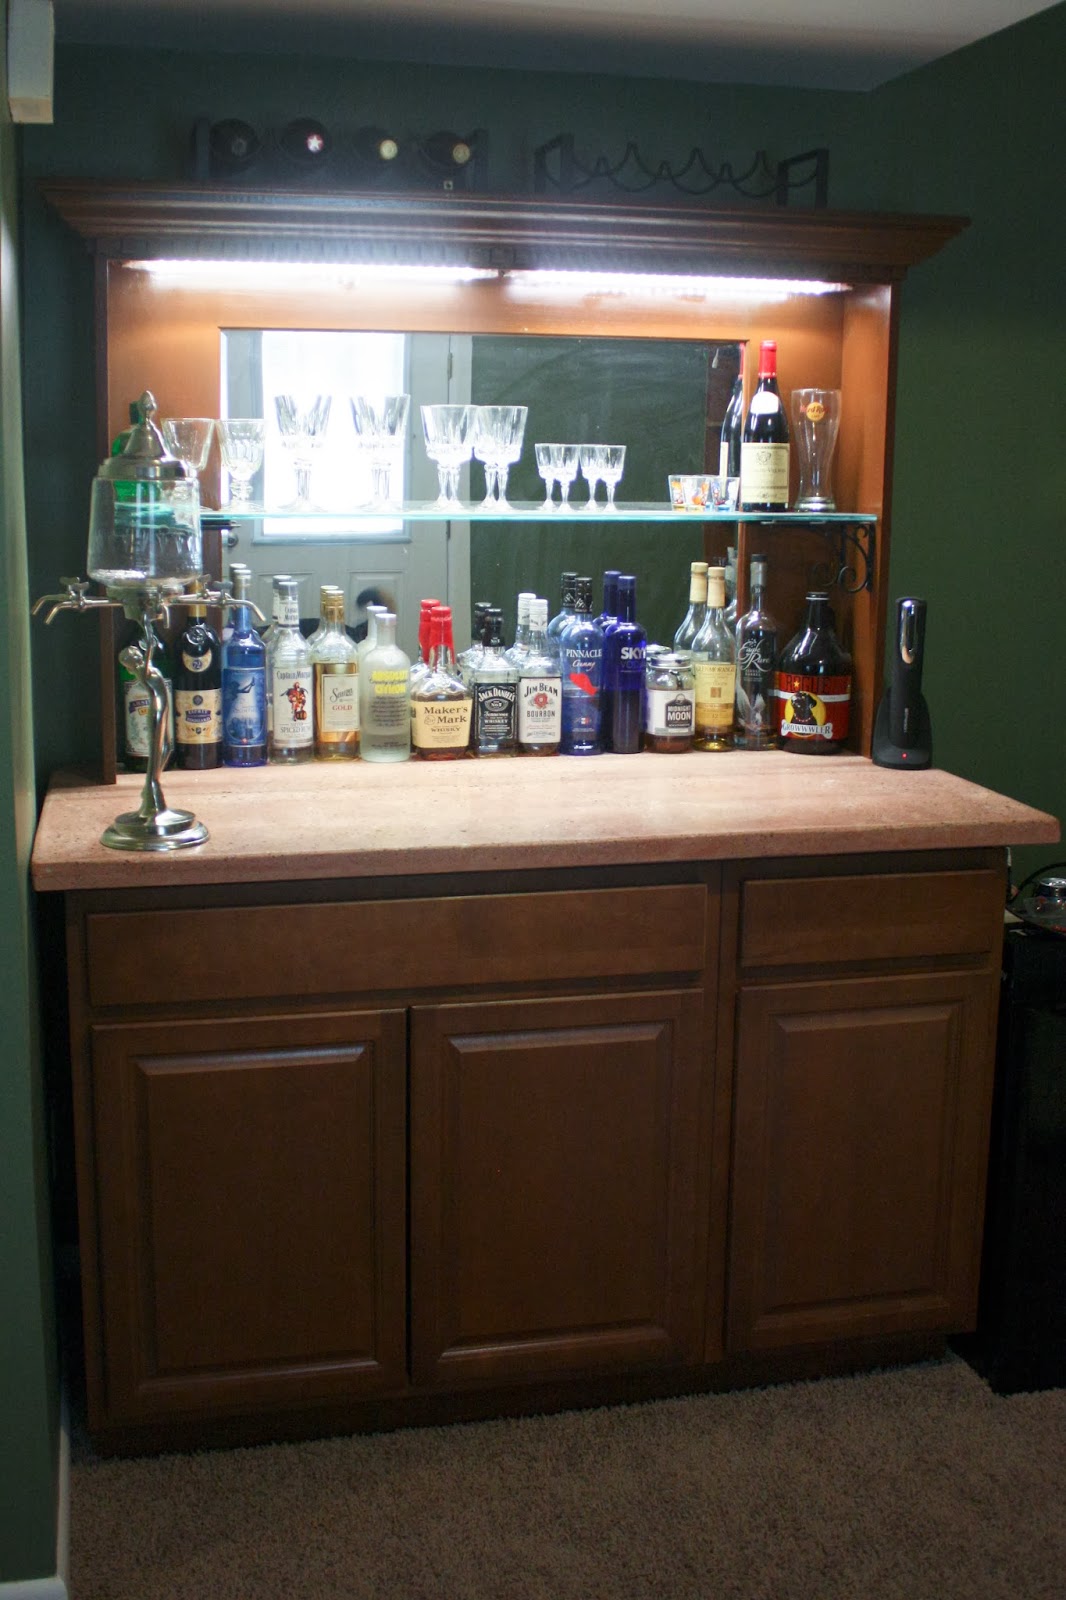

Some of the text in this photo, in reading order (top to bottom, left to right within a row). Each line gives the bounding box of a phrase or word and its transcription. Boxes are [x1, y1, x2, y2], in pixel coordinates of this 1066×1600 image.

[566, 648, 603, 659] PINNACLE
[525, 683, 559, 698] JIM BEAM
[424, 706, 468, 714] Maker's
[527, 710, 556, 718] BOURBON
[437, 715, 467, 724] Mark
[667, 711, 693, 721] MOON
